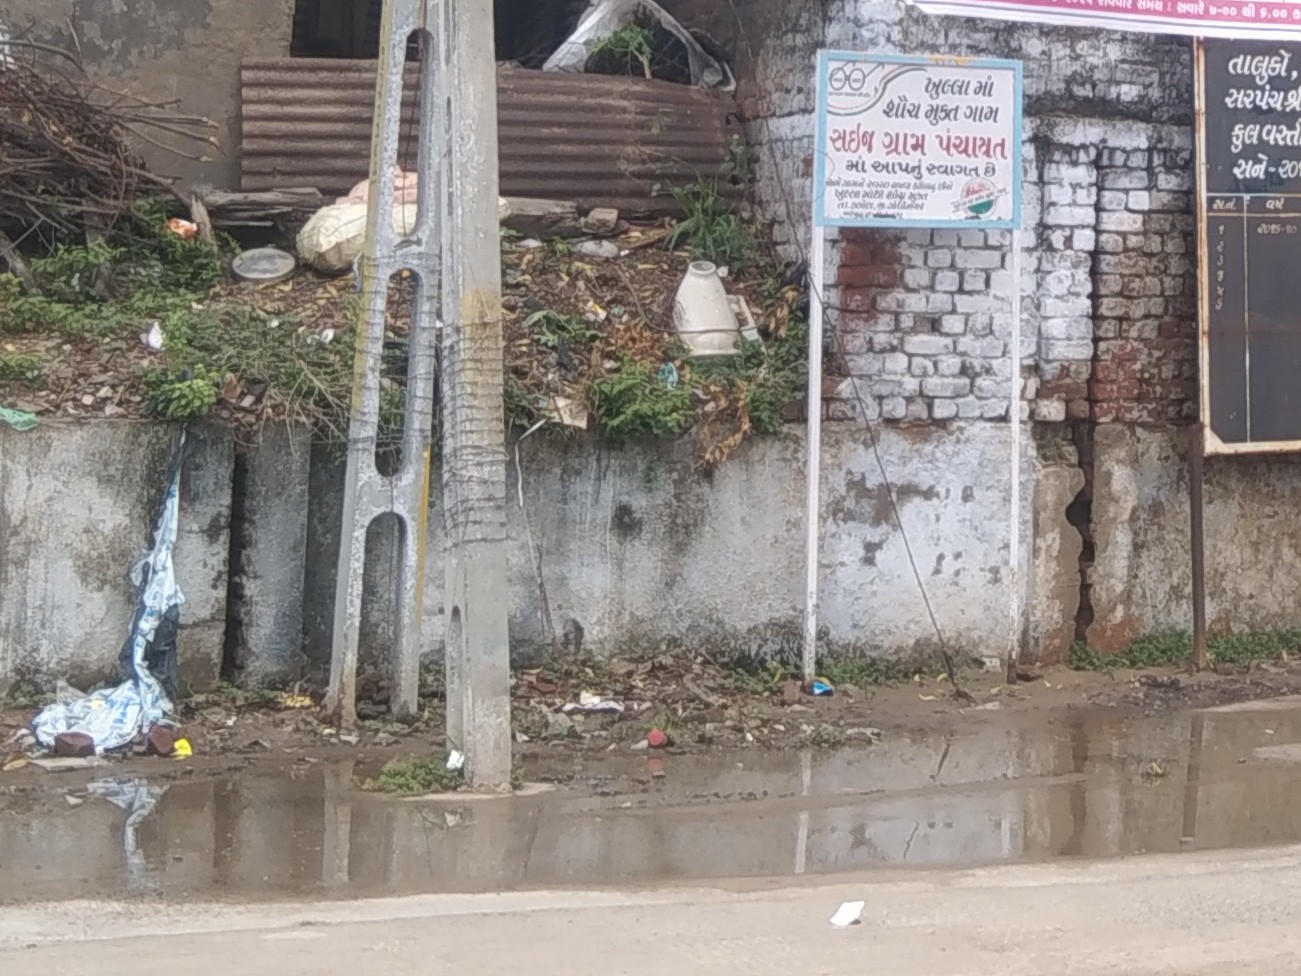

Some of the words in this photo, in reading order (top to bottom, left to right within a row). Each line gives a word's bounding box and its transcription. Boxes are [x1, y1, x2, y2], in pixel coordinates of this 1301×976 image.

[1176, 0, 1204, 15] સવારે
[924, 76, 969, 100] ખુલ્લા
[973, 75, 995, 97] માં
[882, 94, 921, 120] શૌચ
[924, 102, 959, 126] મુક્ત
[963, 104, 999, 124] ગામ
[829, 122, 875, 154] સઈજ
[882, 131, 927, 156] ગ્રામ
[935, 128, 1008, 160] પંચાયત
[1231, 124, 1258, 153] કુલ
[846, 155, 866, 174] માં
[871, 159, 923, 180] આપનું
[926, 163, 981, 178] સ્વાગત
[984, 162, 996, 178] છે
